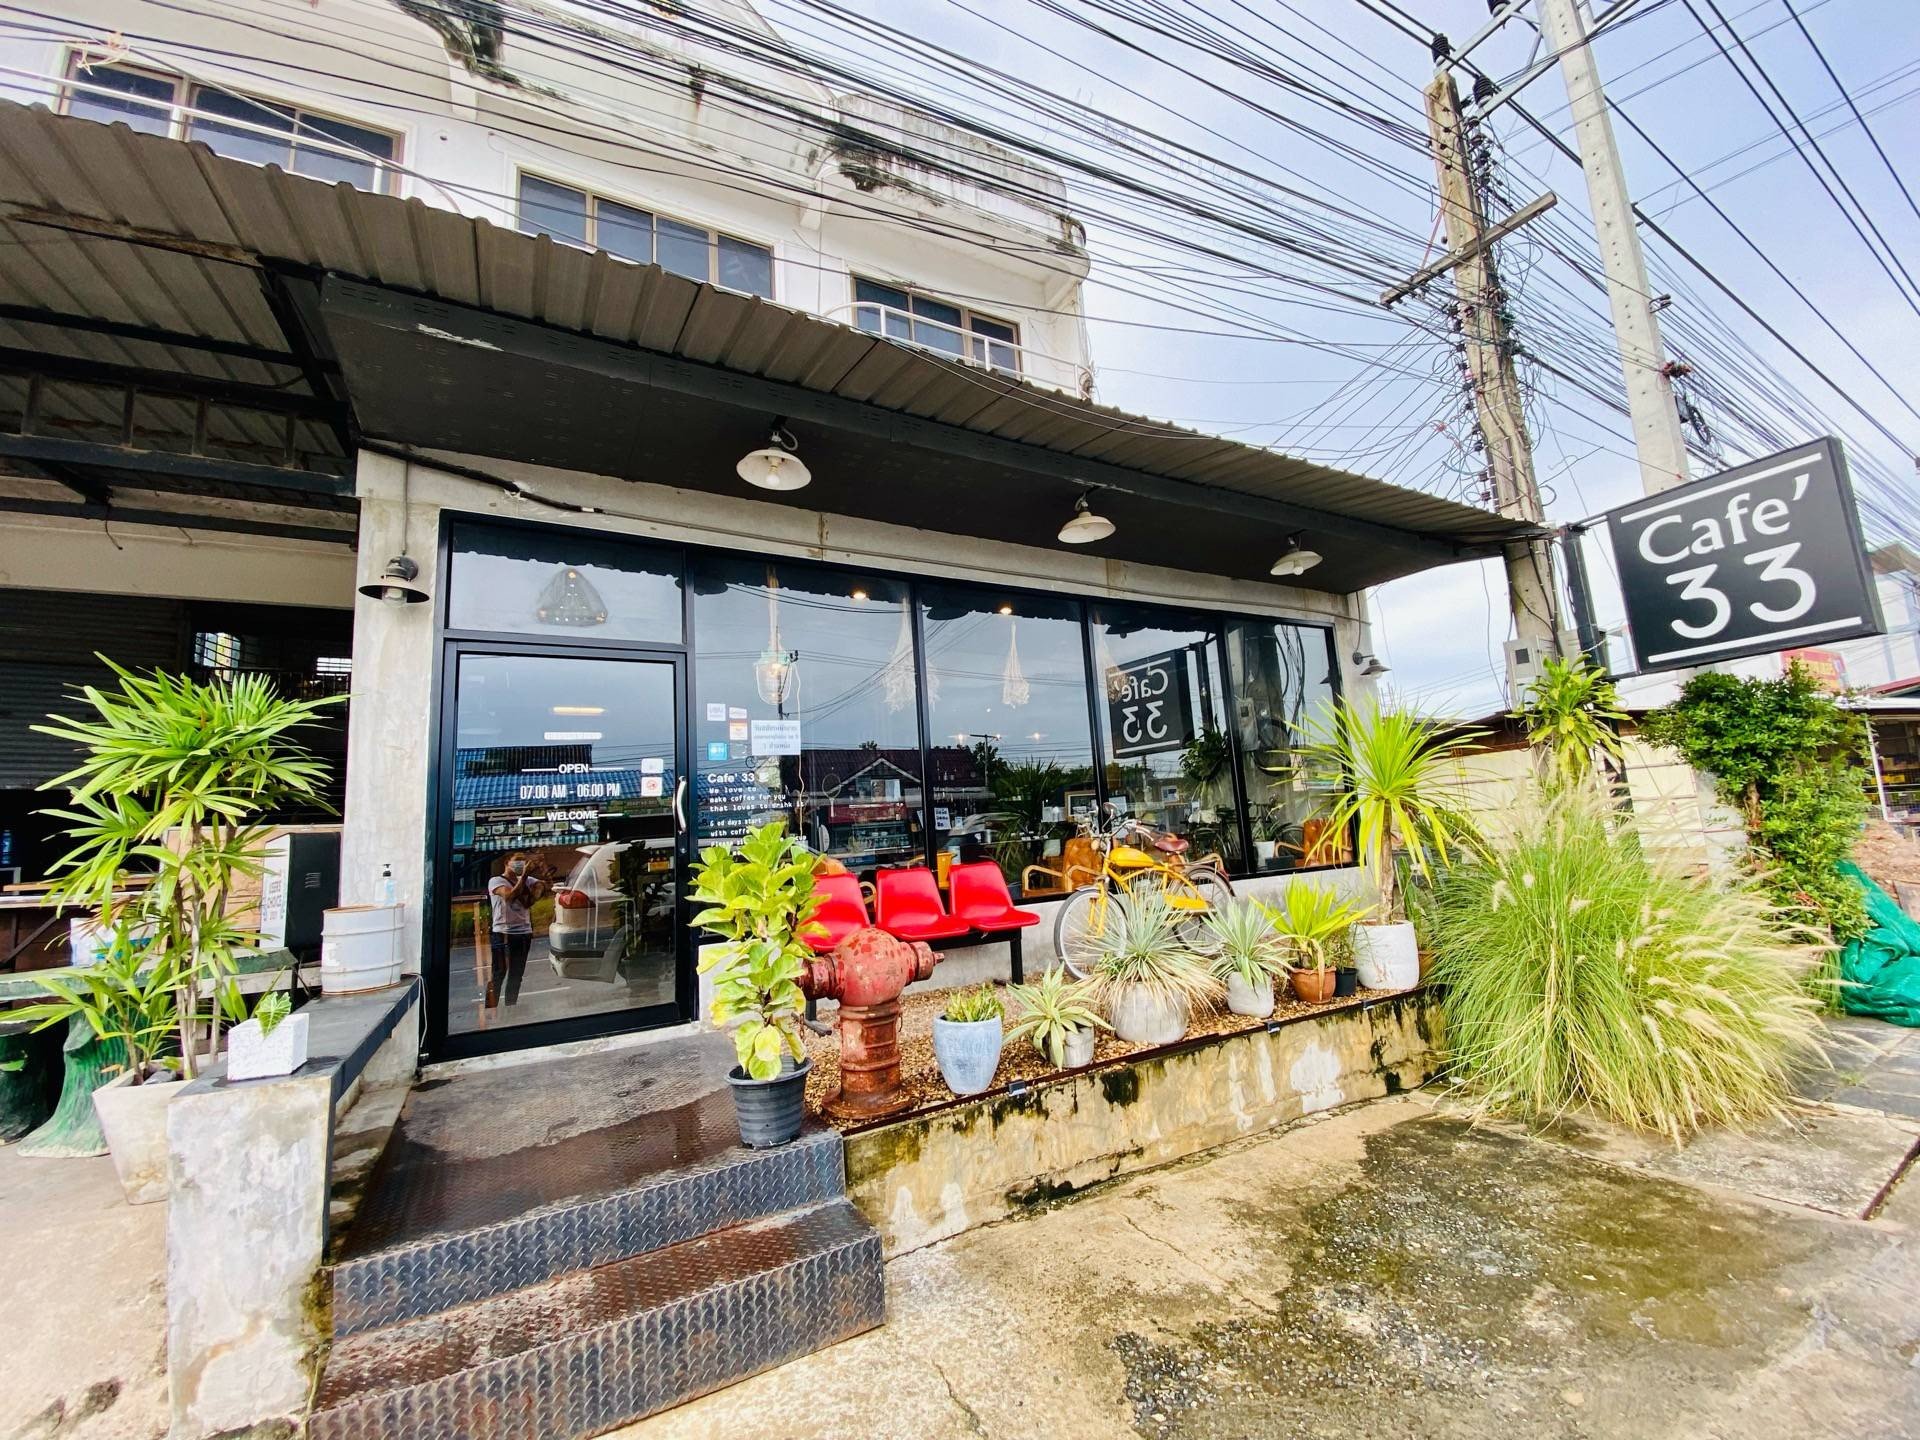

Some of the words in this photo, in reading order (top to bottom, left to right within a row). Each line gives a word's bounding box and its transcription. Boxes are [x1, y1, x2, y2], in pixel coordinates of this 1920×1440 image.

[558, 763, 589, 774] OPEN
[741, 773, 755, 782] 33
[520, 785, 548, 799] 07.00
[551, 784, 567, 798] AM
[577, 783, 604, 798] 06.00
[606, 782, 620, 797] PM
[724, 786, 743, 794] love
[730, 794, 756, 802] coffee
[773, 794, 786, 802] you
[546, 810, 599, 821] WELCOME
[727, 819, 742, 827] days
[710, 829, 727, 837] with
